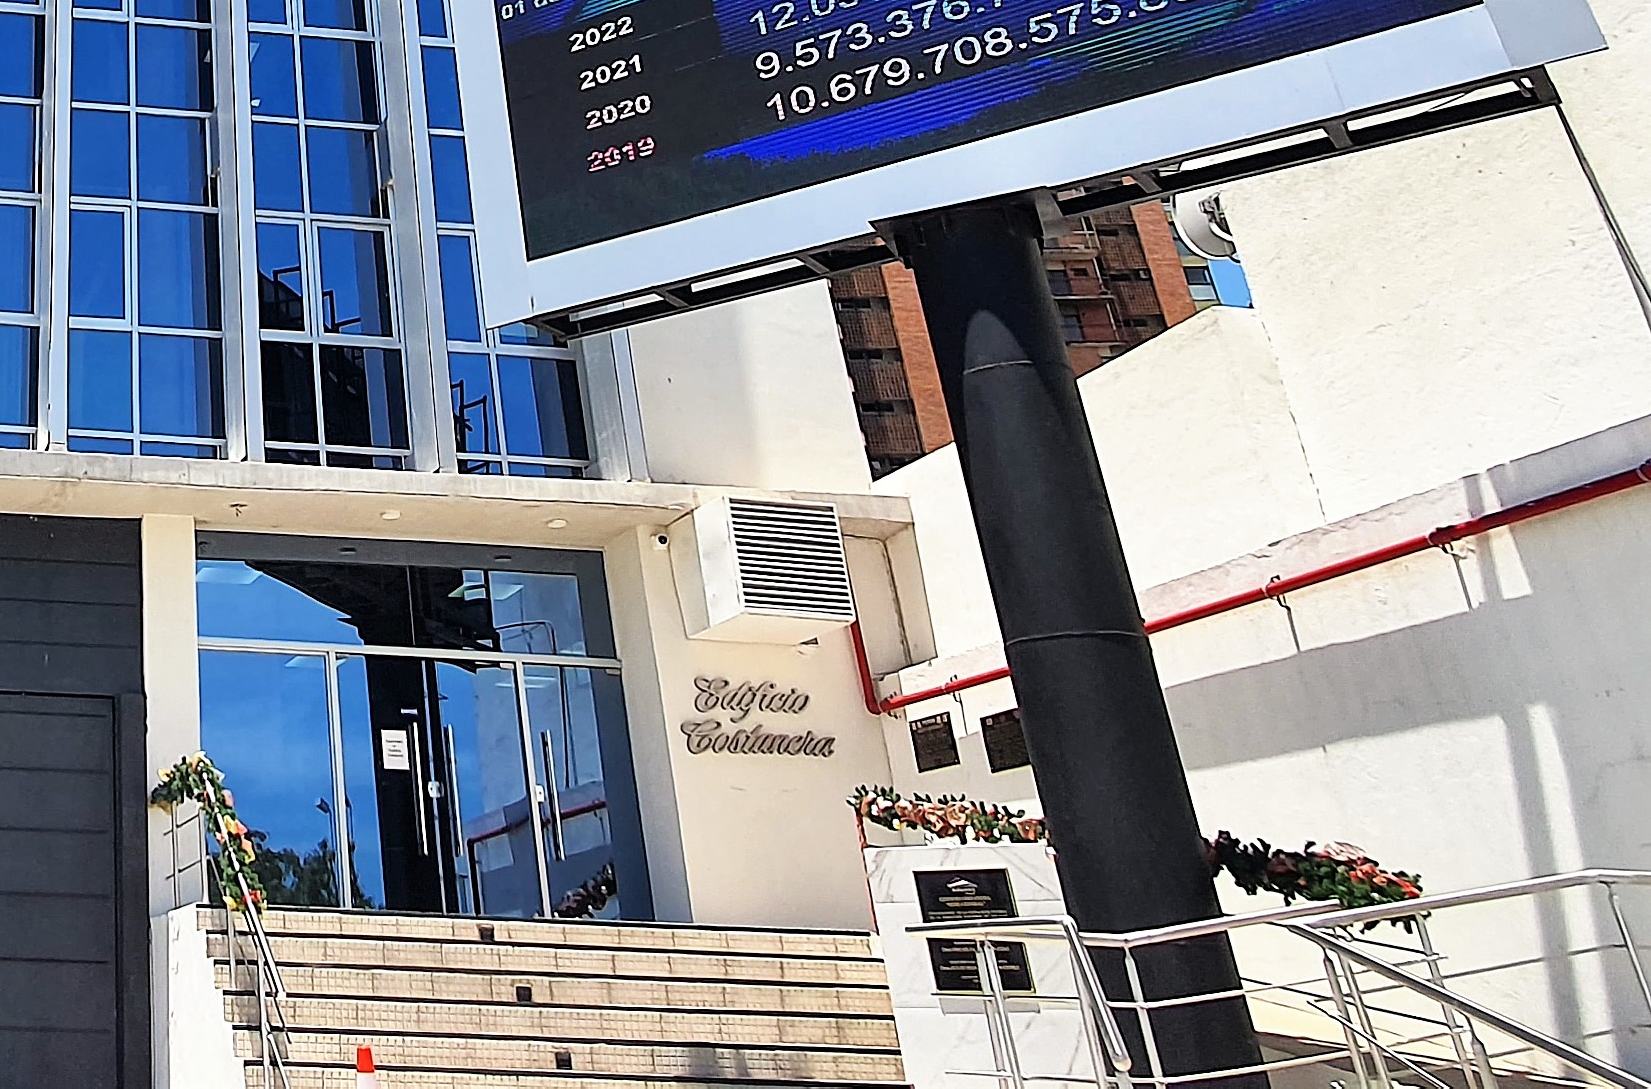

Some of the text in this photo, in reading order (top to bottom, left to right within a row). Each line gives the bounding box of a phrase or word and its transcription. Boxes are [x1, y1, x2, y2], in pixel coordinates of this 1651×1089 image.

[501, 0, 525, 20] 01
[568, 16, 634, 53] 2022
[579, 54, 642, 91] 2021
[585, 95, 651, 130] 2020
[587, 136, 655, 172] 2019
[693, 675, 809, 723] Edificio
[680, 719, 836, 758] Costanera
